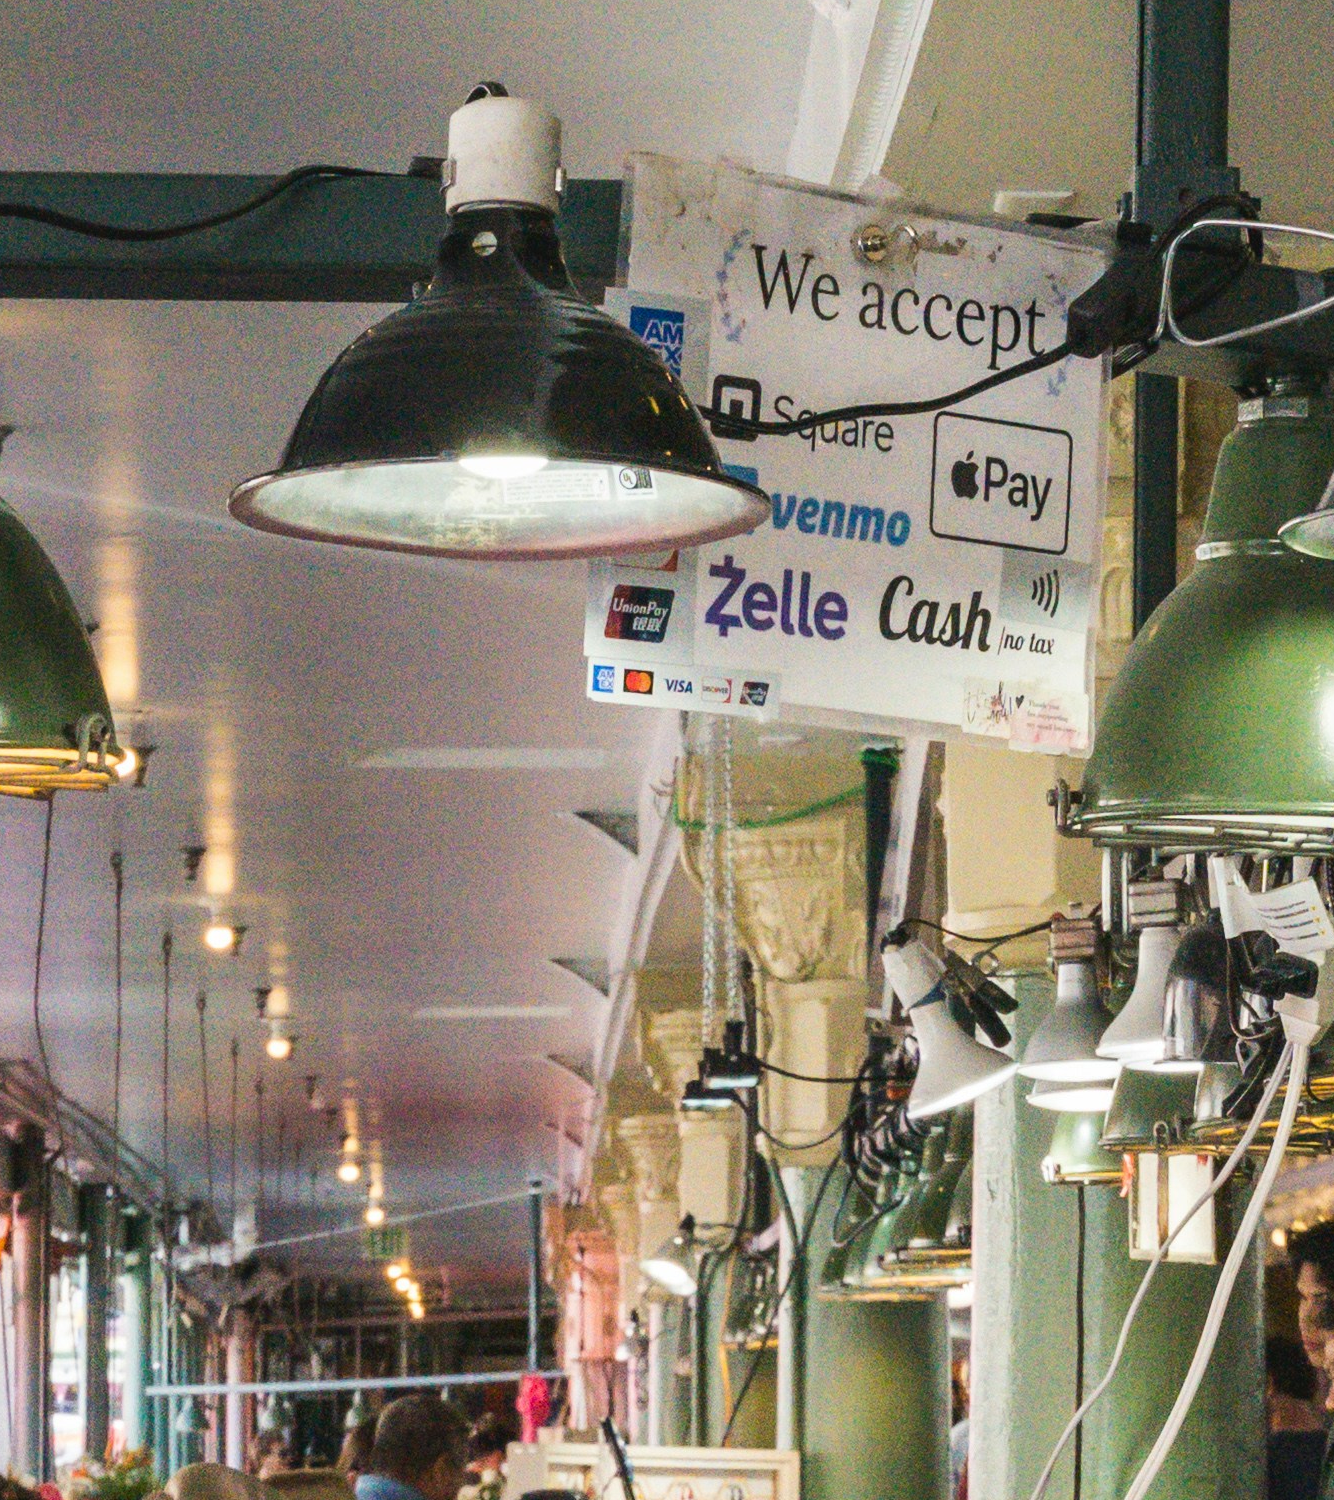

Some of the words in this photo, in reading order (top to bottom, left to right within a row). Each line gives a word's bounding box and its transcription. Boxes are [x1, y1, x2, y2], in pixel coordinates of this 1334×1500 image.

[749, 244, 840, 321] We
[859, 281, 1046, 370] accept
[774, 395, 895, 452] Square
[771, 492, 912, 547] venmo
[983, 455, 1053, 522] Pay
[612, 597, 669, 622] UnionPay
[704, 554, 849, 641] Zelle
[878, 574, 991, 652] Cash
[1029, 632, 1055, 655] tax
[665, 678, 693, 694] VISA
